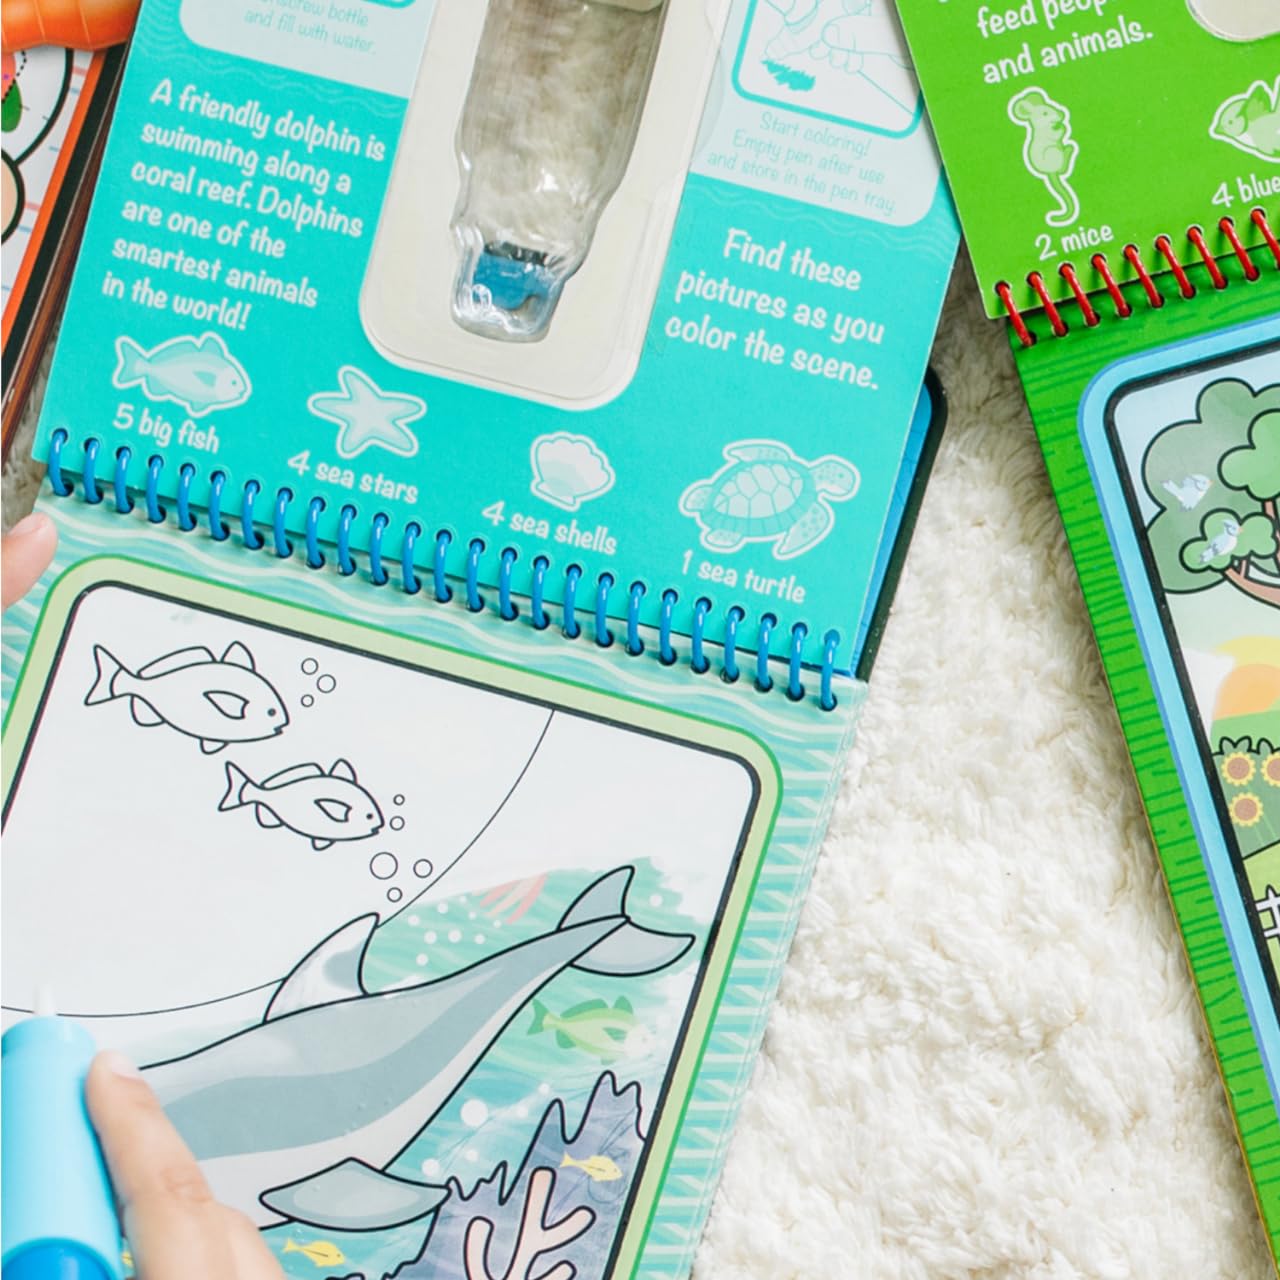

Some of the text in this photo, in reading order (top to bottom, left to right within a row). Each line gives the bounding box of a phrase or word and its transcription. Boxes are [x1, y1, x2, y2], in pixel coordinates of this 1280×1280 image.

[977, 0, 1038, 38] feed
[983, 15, 1154, 85] and animals.
[150, 79, 387, 162] A friendly dolphin is
[759, 111, 872, 158] Start coloring!
[140, 122, 352, 195] swimming along a
[707, 151, 738, 171] and
[741, 158, 780, 180] store
[783, 167, 799, 186] in
[804, 172, 827, 193] the
[830, 181, 859, 204] pen
[733, 129, 885, 185] Empty pen after use
[131, 160, 364, 238] coral reef. Dolphins
[1211, 182, 1234, 209] 4
[121, 199, 286, 259] are one of the
[1035, 224, 1115, 261] 2 mice
[112, 238, 318, 308] smartest animals
[723, 227, 861, 291] Find these
[102, 272, 251, 330] in the world!
[675, 271, 884, 344] pictures as you
[665, 315, 879, 390] color the scene.
[113, 403, 220, 453] 5 big fish
[287, 450, 418, 504] 4 sea stars
[481, 501, 617, 556] 4 sea shells
[682, 549, 806, 604] 1 sea turtle
